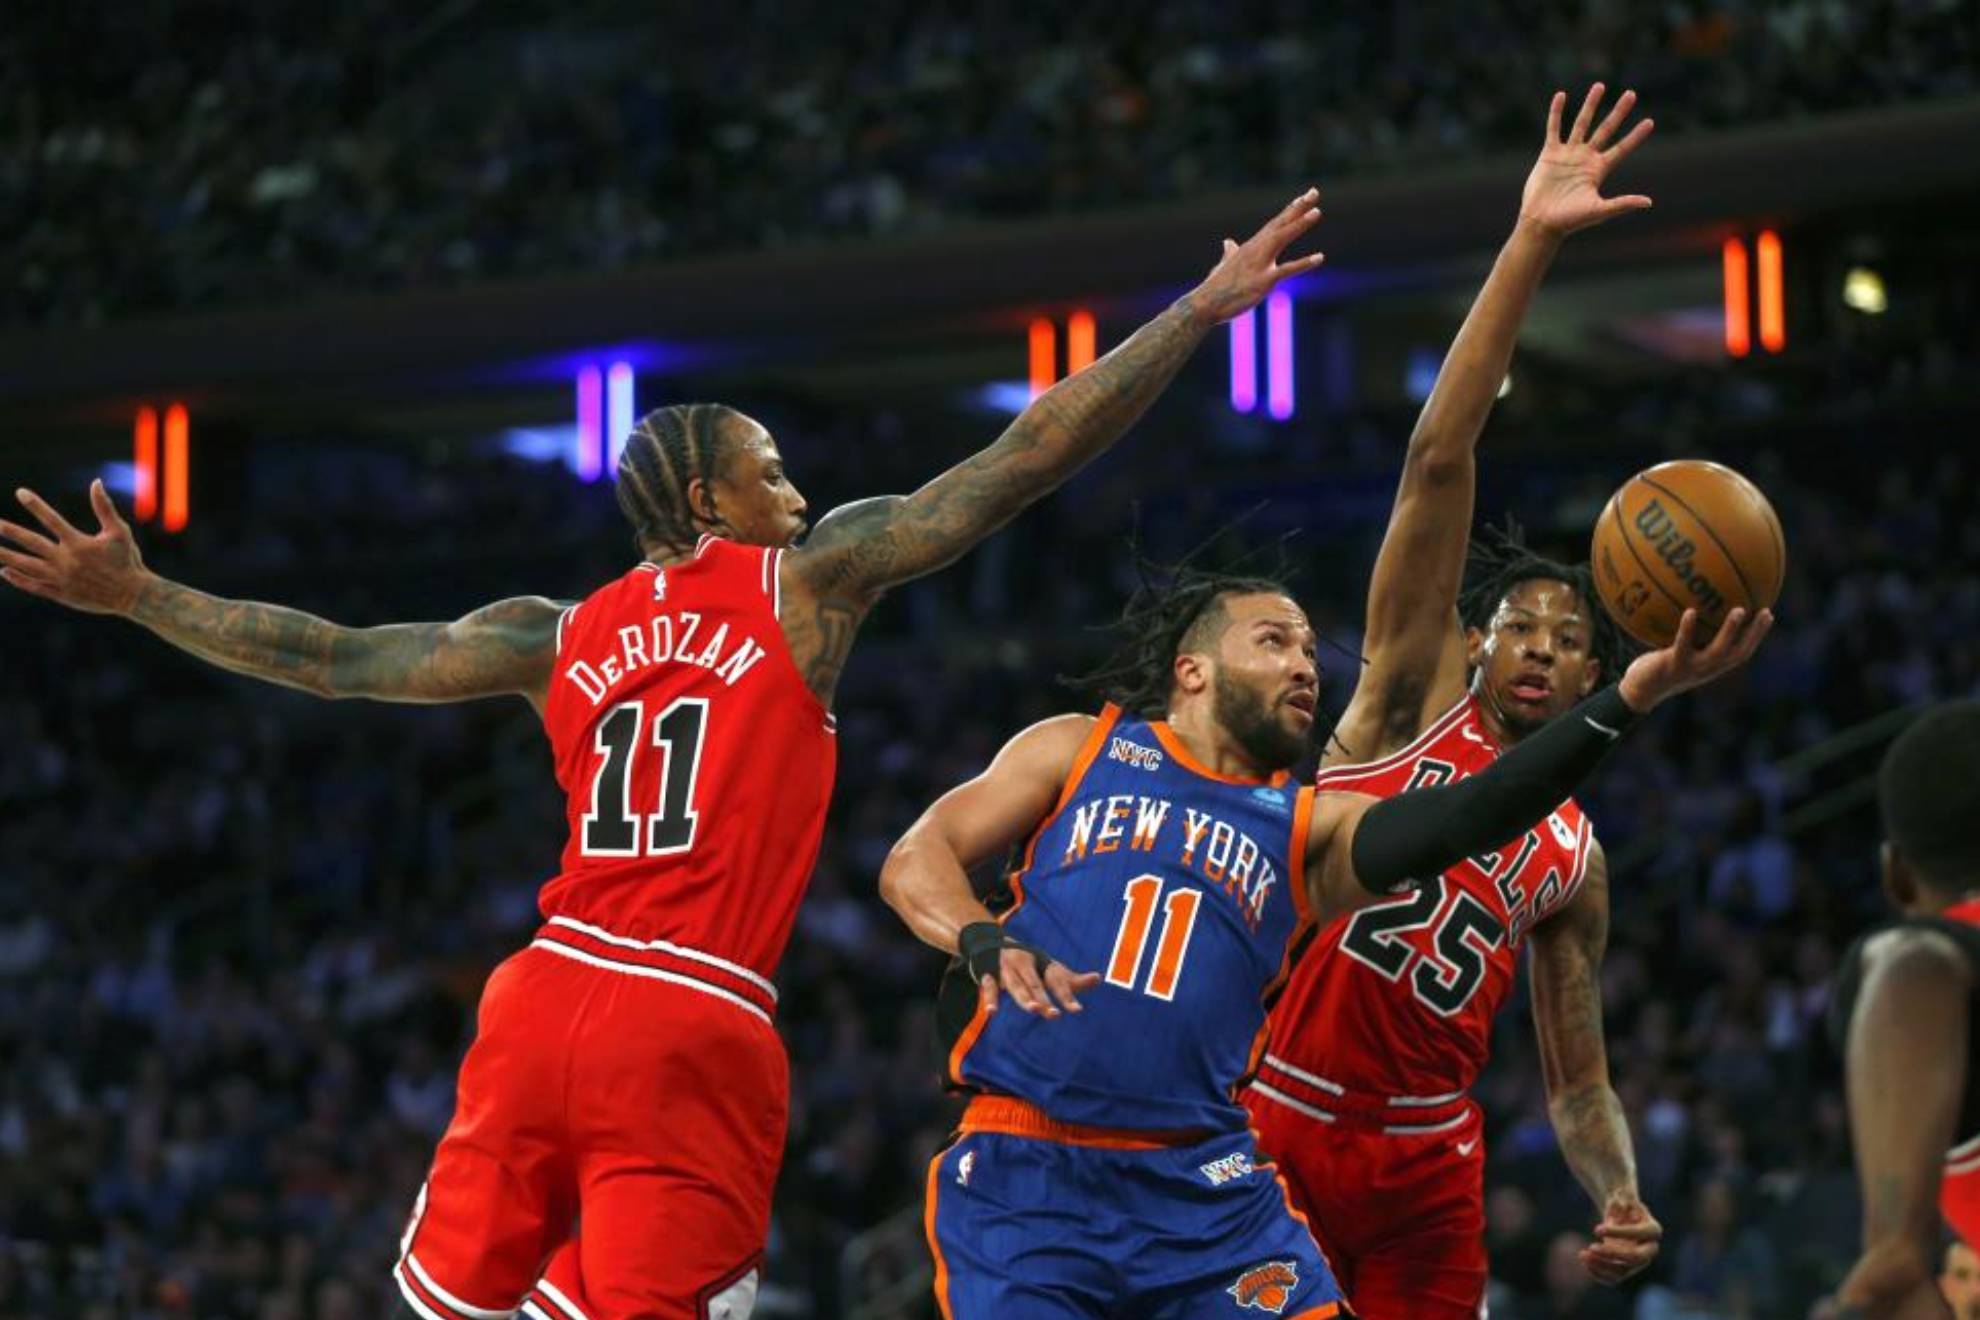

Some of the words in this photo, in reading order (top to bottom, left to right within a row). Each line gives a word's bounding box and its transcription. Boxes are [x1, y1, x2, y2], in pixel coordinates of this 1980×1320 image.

[1636, 498, 1723, 611] Wilson
[580, 696, 710, 858] 11
[1108, 737, 1163, 771] NYC
[1062, 794, 1172, 864] NEW
[1181, 807, 1278, 933] YORK
[1104, 873, 1203, 1003] 11
[1338, 868, 1506, 1018] 25
